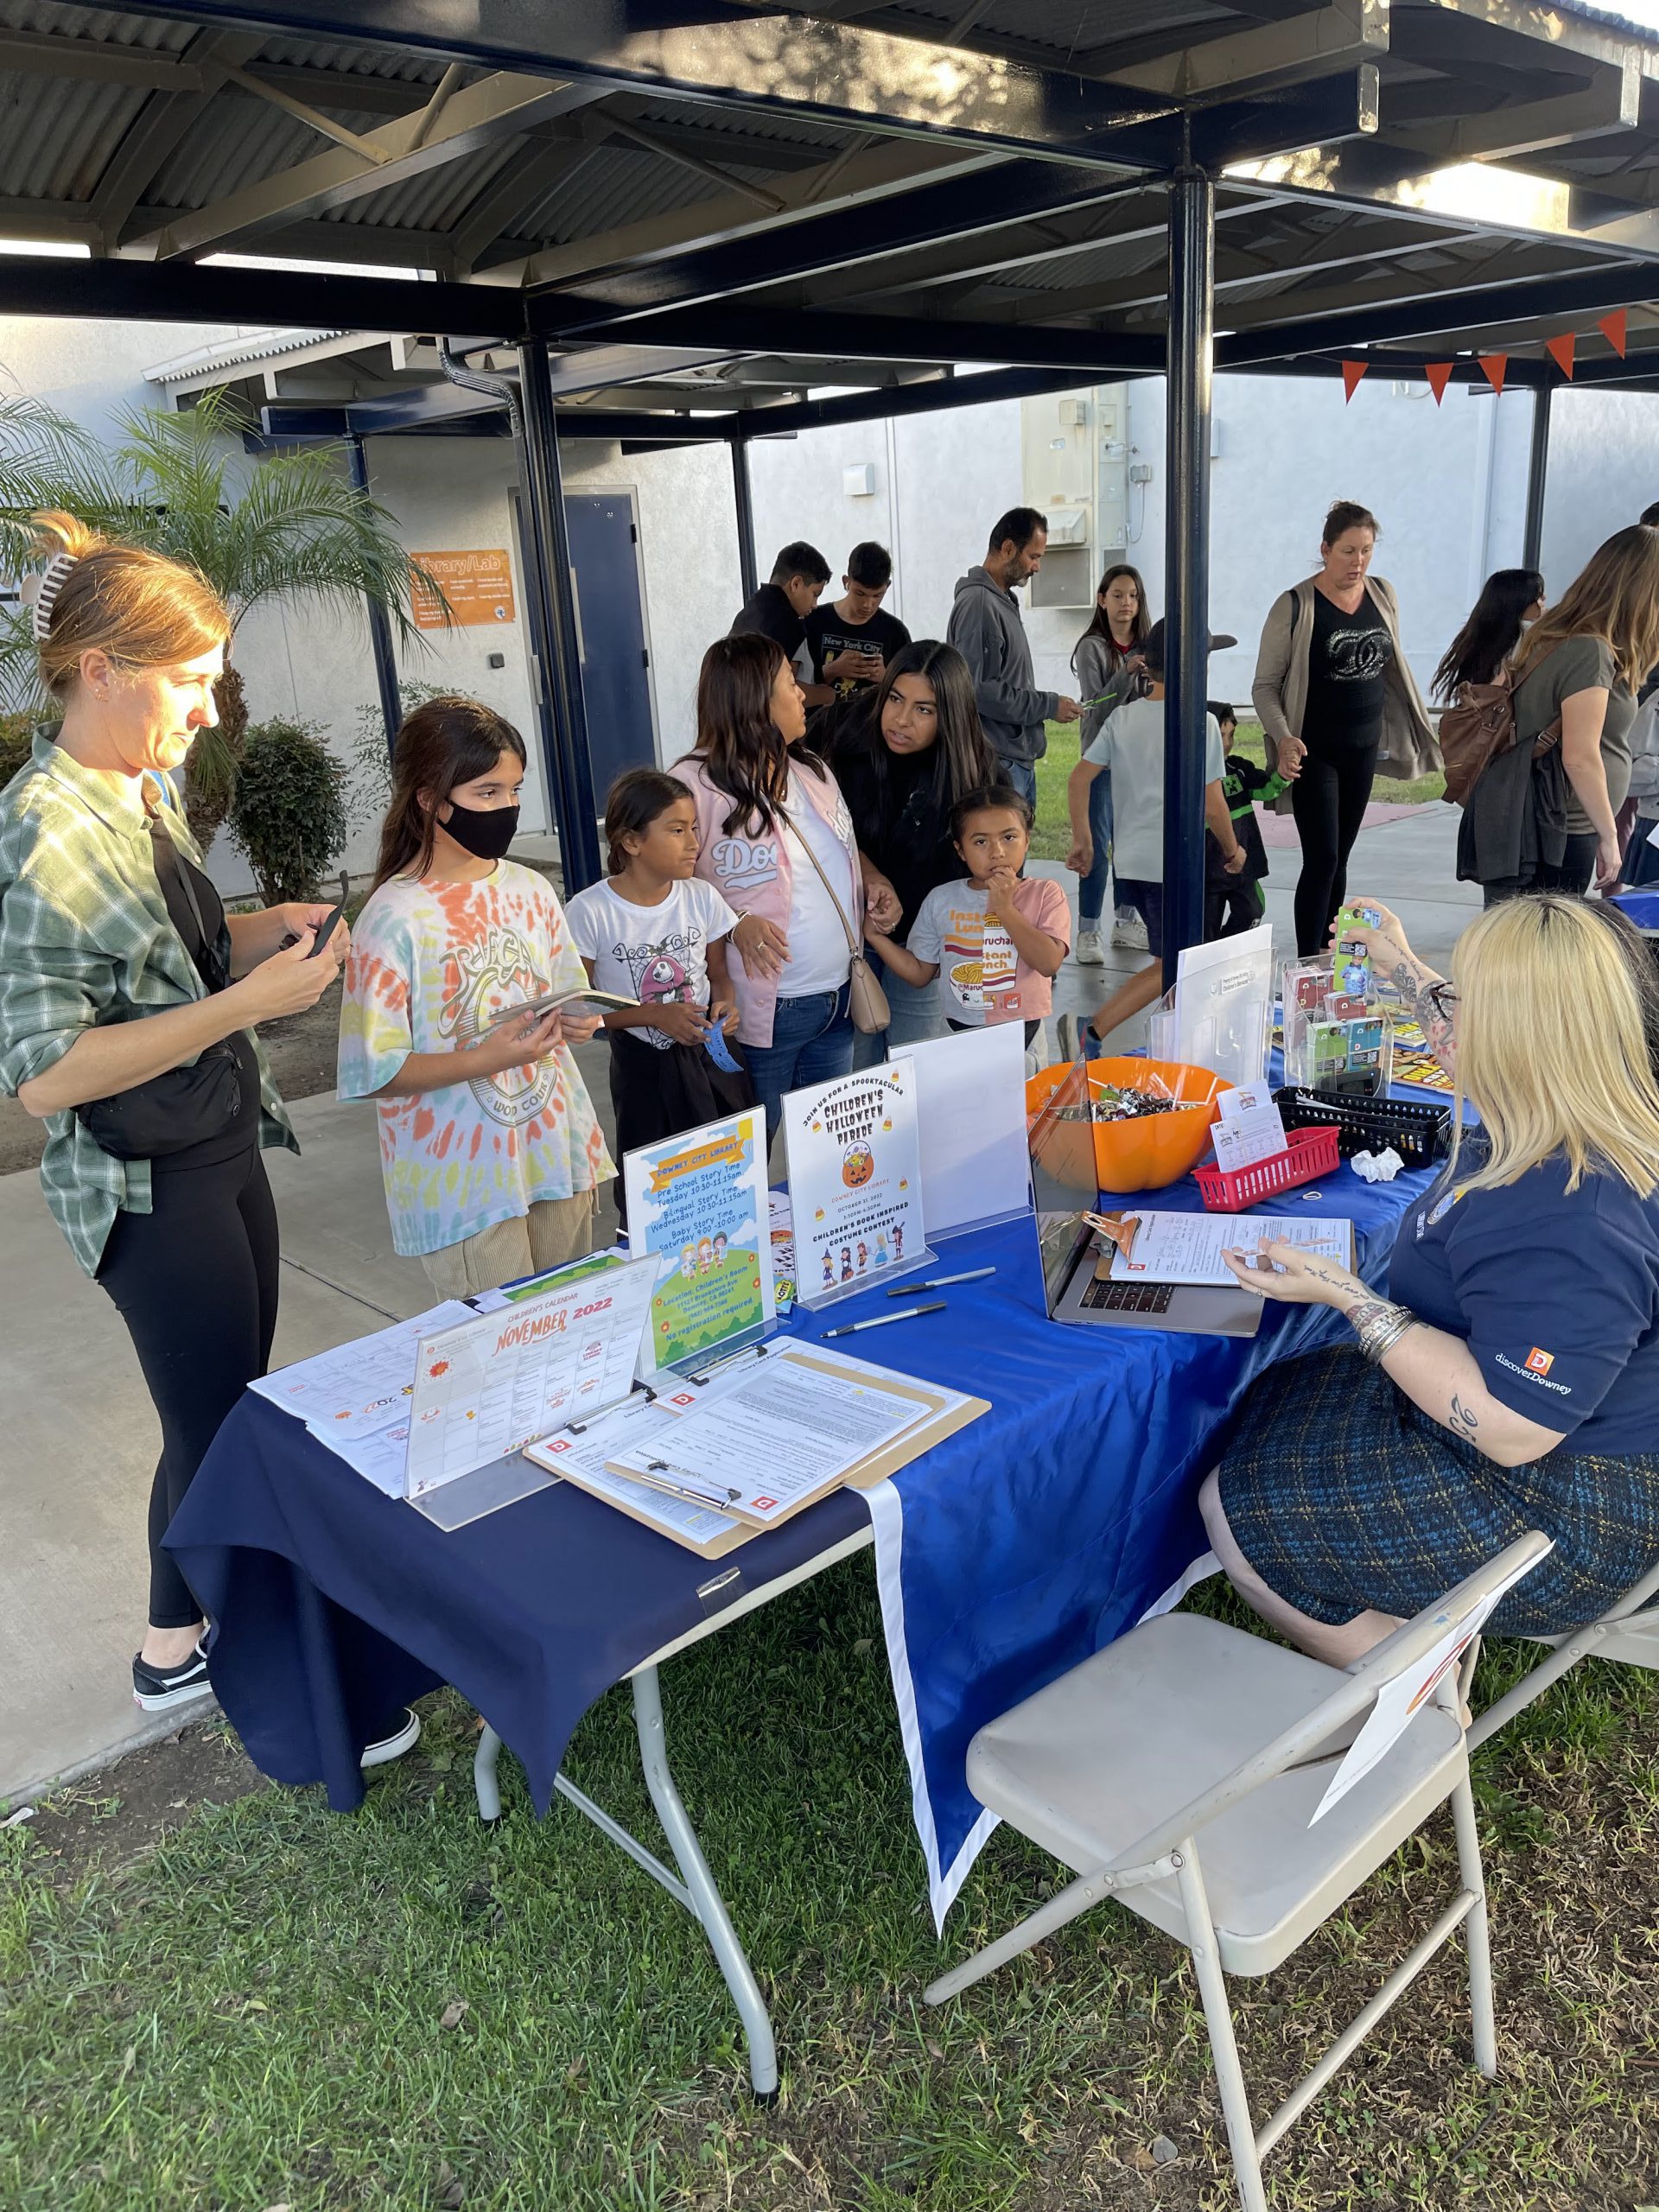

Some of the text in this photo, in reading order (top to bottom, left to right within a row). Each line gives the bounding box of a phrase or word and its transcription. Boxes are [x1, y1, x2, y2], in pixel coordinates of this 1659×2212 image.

[824, 637, 881, 653] New York City
[982, 937, 1014, 946] rucha
[982, 950, 1012, 960] tant
[522, 1082, 548, 1111] TOUR
[803, 1107, 818, 1127] JOIN
[817, 1096, 828, 1108] US
[828, 1086, 842, 1099] FOR
[851, 1077, 904, 1096] SPOOKTACULAR
[823, 1089, 884, 1119] CHILDREN'S
[825, 1104, 884, 1134] HALLOWEEN
[836, 1122, 873, 1146] PARADE
[658, 1142, 738, 1178] DOWNEY CITY LIBRARY
[658, 1163, 741, 1198] Pre School Story Time
[658, 1191, 689, 1207] Tuesday
[664, 1186, 738, 1219] Bilingual Story Time
[838, 1201, 861, 1212] OCTOBER
[652, 1211, 694, 1234] Wednesday
[659, 1235, 695, 1252] Saturday
[738, 1211, 749, 1219] am
[671, 1209, 733, 1239] Baby Story Time
[812, 1201, 909, 1243] CHILDREN'S BOOK INSPIRED
[829, 1217, 895, 1247] COSTUME CONTEST
[696, 1274, 728, 1293] Children's
[729, 1266, 748, 1277] Room
[778, 1281, 790, 1300] LOTTE
[507, 1293, 578, 1323] CHILDREN'S CALENDAR
[491, 1297, 613, 1357] NOVEMBER 2022
[665, 1332, 677, 1341] No
[1495, 1353, 1572, 1395] discoverDowney
